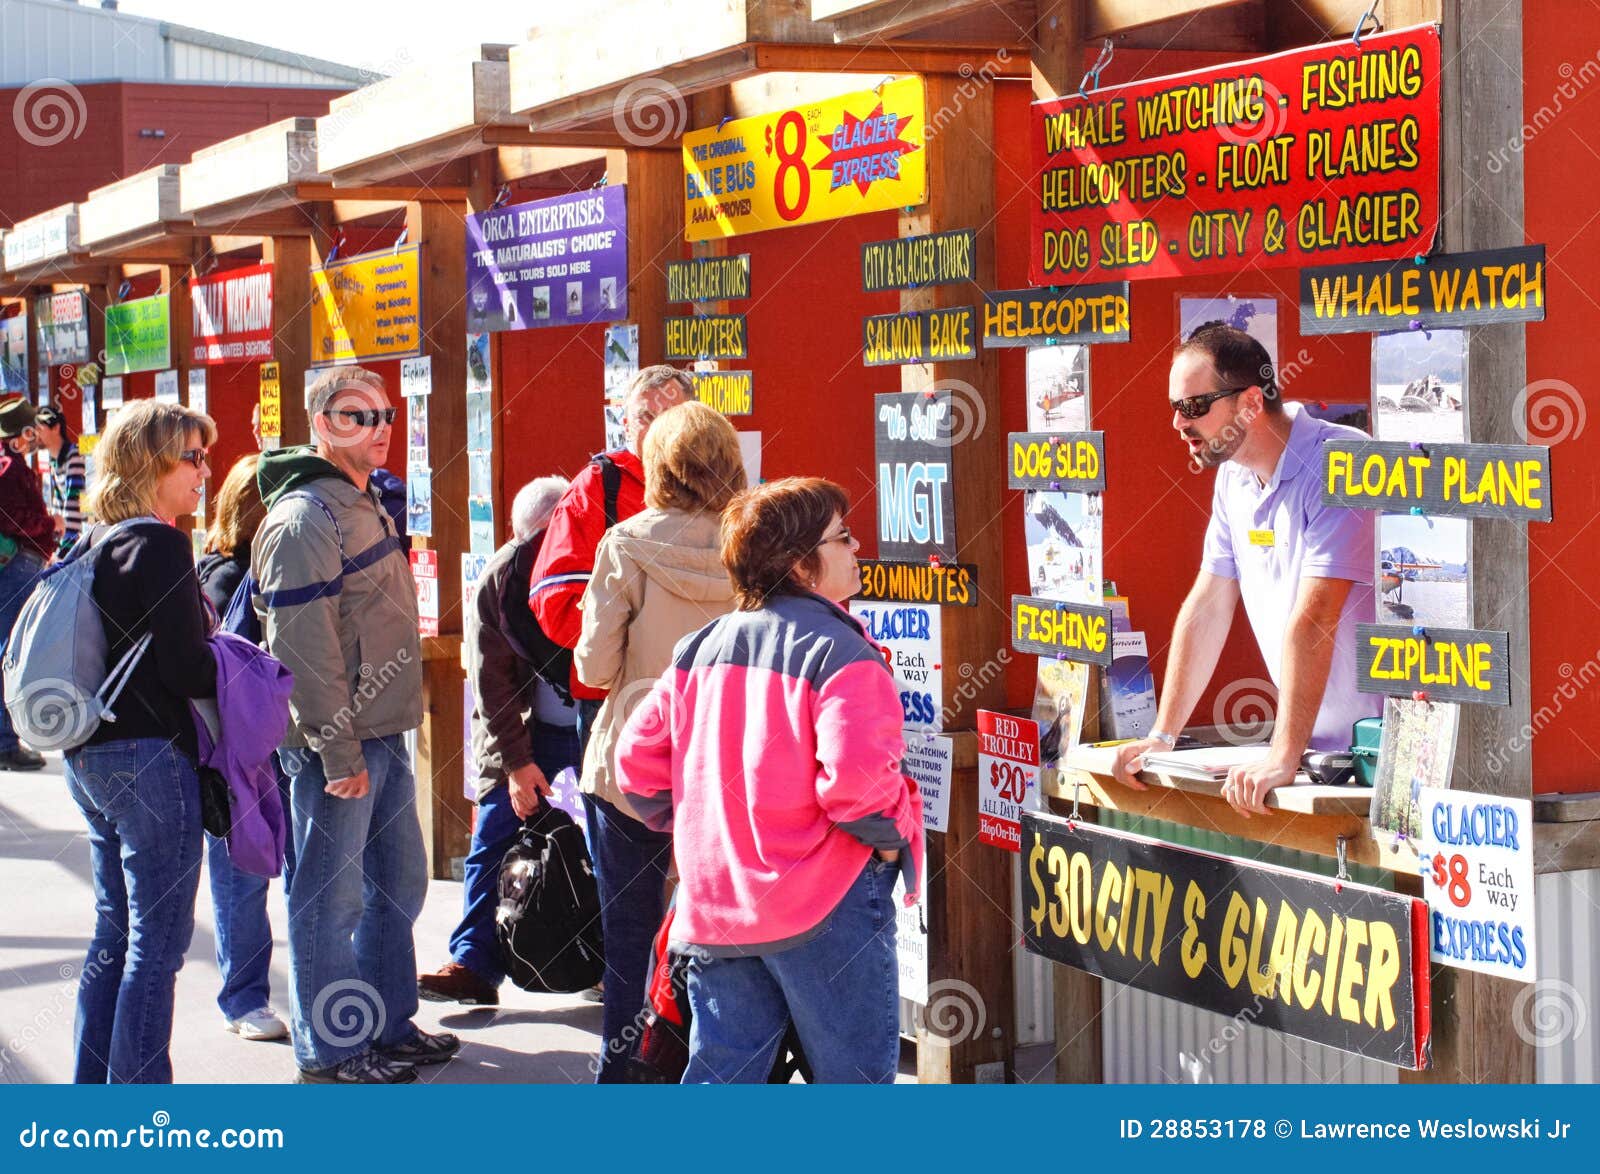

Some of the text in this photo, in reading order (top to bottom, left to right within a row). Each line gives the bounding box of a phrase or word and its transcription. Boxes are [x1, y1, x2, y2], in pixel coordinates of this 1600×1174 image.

[1044, 101, 1125, 155] WHALE
[1136, 73, 1264, 141] WATCHING
[1302, 45, 1422, 112] FISHING
[692, 136, 747, 162] THE ORIGINAL
[832, 112, 898, 152] GLACIER
[687, 160, 755, 200] BLUE BUS
[764, 110, 811, 222] $8
[831, 150, 900, 189] EXPRESS
[1041, 151, 1187, 212] HELICOPTERS
[1216, 136, 1295, 192] FLOAT
[1307, 117, 1420, 181] PLANES
[482, 196, 605, 243] ORCA ENTERPRISES
[1042, 228, 1089, 273] DOG
[1100, 219, 1159, 267] SLED
[1188, 210, 1252, 260] CITY
[1263, 207, 1285, 254] &
[1298, 192, 1422, 251] GLACIER
[496, 238, 568, 264] NATURALISTS'
[571, 230, 617, 253] CHOICE"
[865, 233, 970, 288] CITY & GLACIER TOURS
[494, 260, 591, 285] LOCAL TOURS SOLD HERE
[668, 262, 682, 301] CITY
[691, 261, 721, 298] GLACIER
[722, 257, 747, 296] TOURS
[1311, 261, 1543, 319] WHALE WATCH
[226, 272, 273, 334] WATCHING
[984, 294, 1130, 337] HELICOPTER
[208, 341, 244, 360] GUARANTEED
[245, 340, 271, 357] SIGHTING
[666, 317, 742, 357] HELICOPTERS
[866, 311, 971, 362] SALMON BAKE
[403, 363, 429, 386] Fishing
[699, 375, 750, 413] WATCHING
[1013, 440, 1099, 480] DOG SLED
[1327, 451, 1542, 509] FLOAT PLANE
[879, 462, 948, 544] MGT
[861, 564, 970, 604] 30 MINUTES
[1017, 604, 1107, 653] FISHING
[896, 650, 926, 668] Each
[903, 669, 929, 684] way
[1369, 637, 1493, 691] ZIPLINE
[982, 733, 1034, 762] TROLLEY
[995, 717, 1019, 739] RED
[913, 771, 942, 786] PANNING
[921, 760, 942, 773] TOURS
[990, 760, 1026, 805] $20
[924, 786, 940, 799] BAKE
[982, 798, 998, 814] ALL
[1000, 801, 1017, 819] DAY
[1432, 801, 1521, 851] GLACIER
[1432, 851, 1472, 908] $8
[1479, 863, 1514, 889] Each
[1487, 889, 1519, 912] way
[1029, 831, 1092, 946] $30
[1095, 860, 1174, 966] CITY
[1219, 890, 1400, 1032] GLACIER
[1433, 910, 1527, 969] EXPRESS
